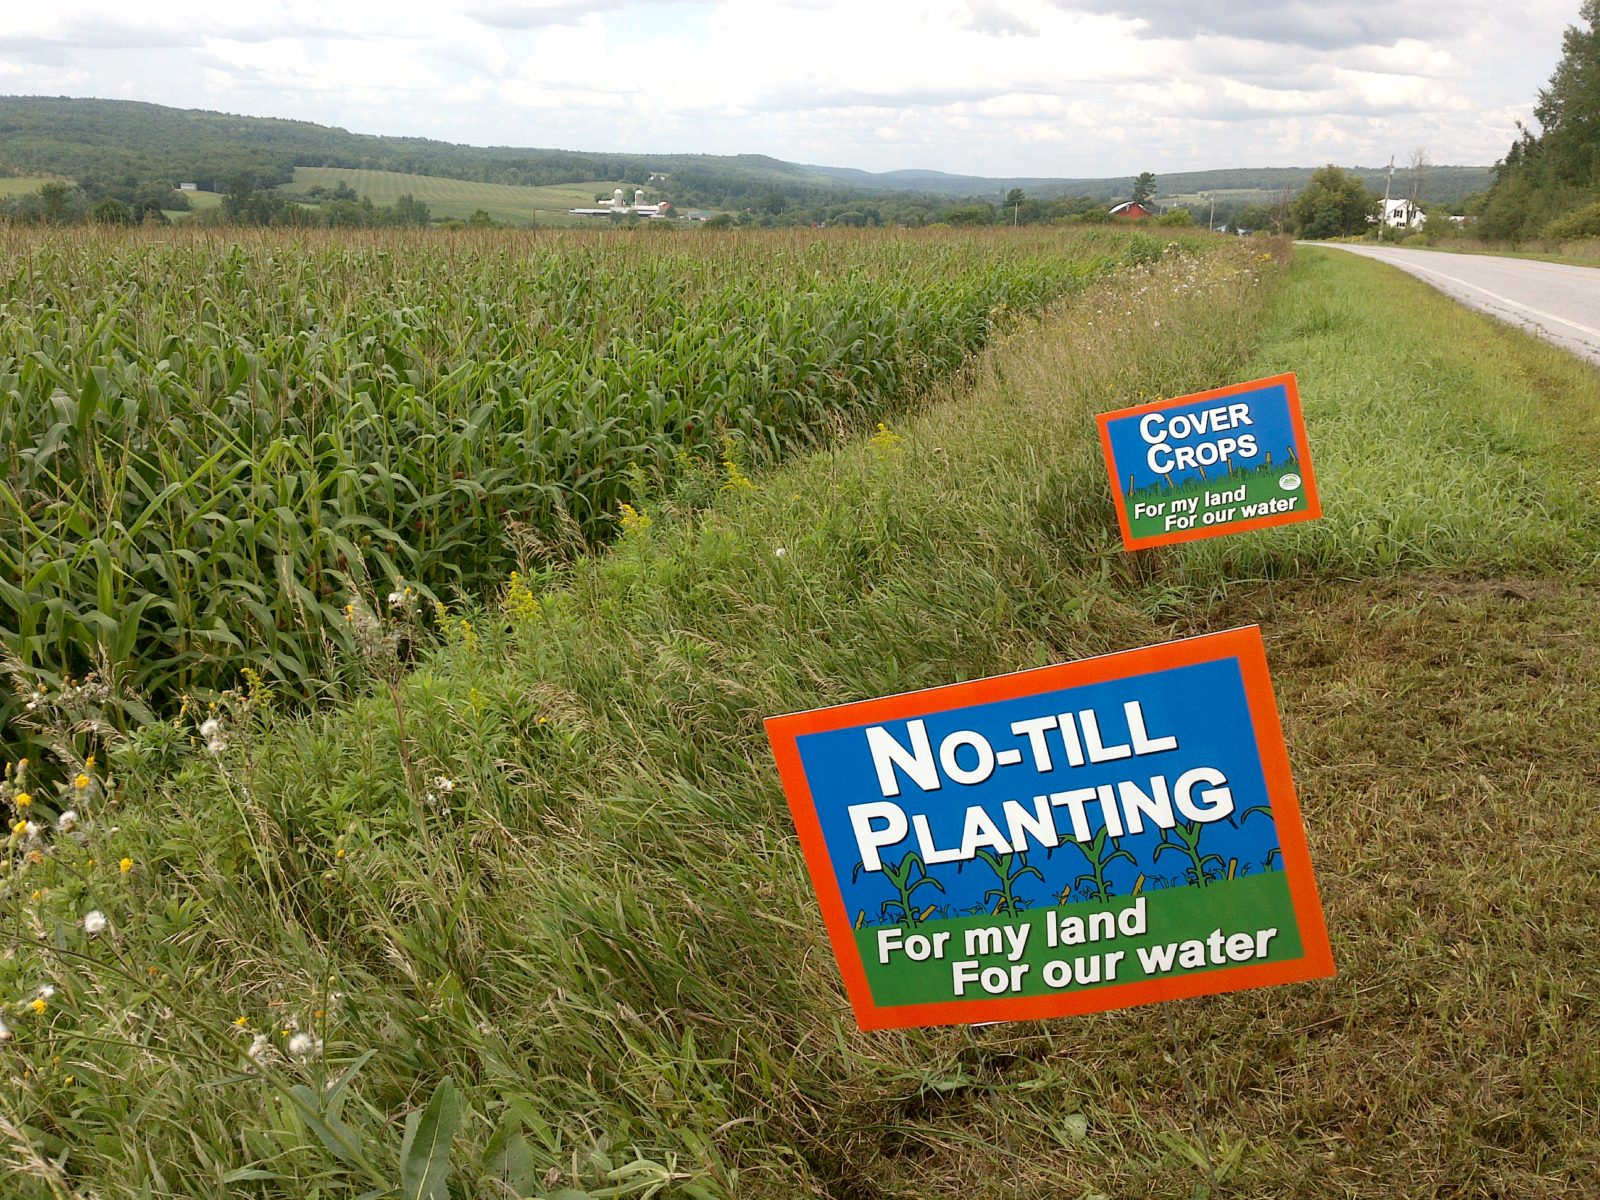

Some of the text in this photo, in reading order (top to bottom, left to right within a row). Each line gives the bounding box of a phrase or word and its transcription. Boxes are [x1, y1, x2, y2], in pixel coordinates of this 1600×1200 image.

[1139, 403, 1253, 444] COVER
[1146, 434, 1258, 474] CROPS
[1134, 485, 1246, 519] For my land
[1164, 496, 1298, 532] For our water
[865, 700, 1177, 797] NO-TILL
[847, 767, 1235, 872] PLANTING
[876, 896, 1148, 964] For my land
[952, 926, 1278, 996] For our water
